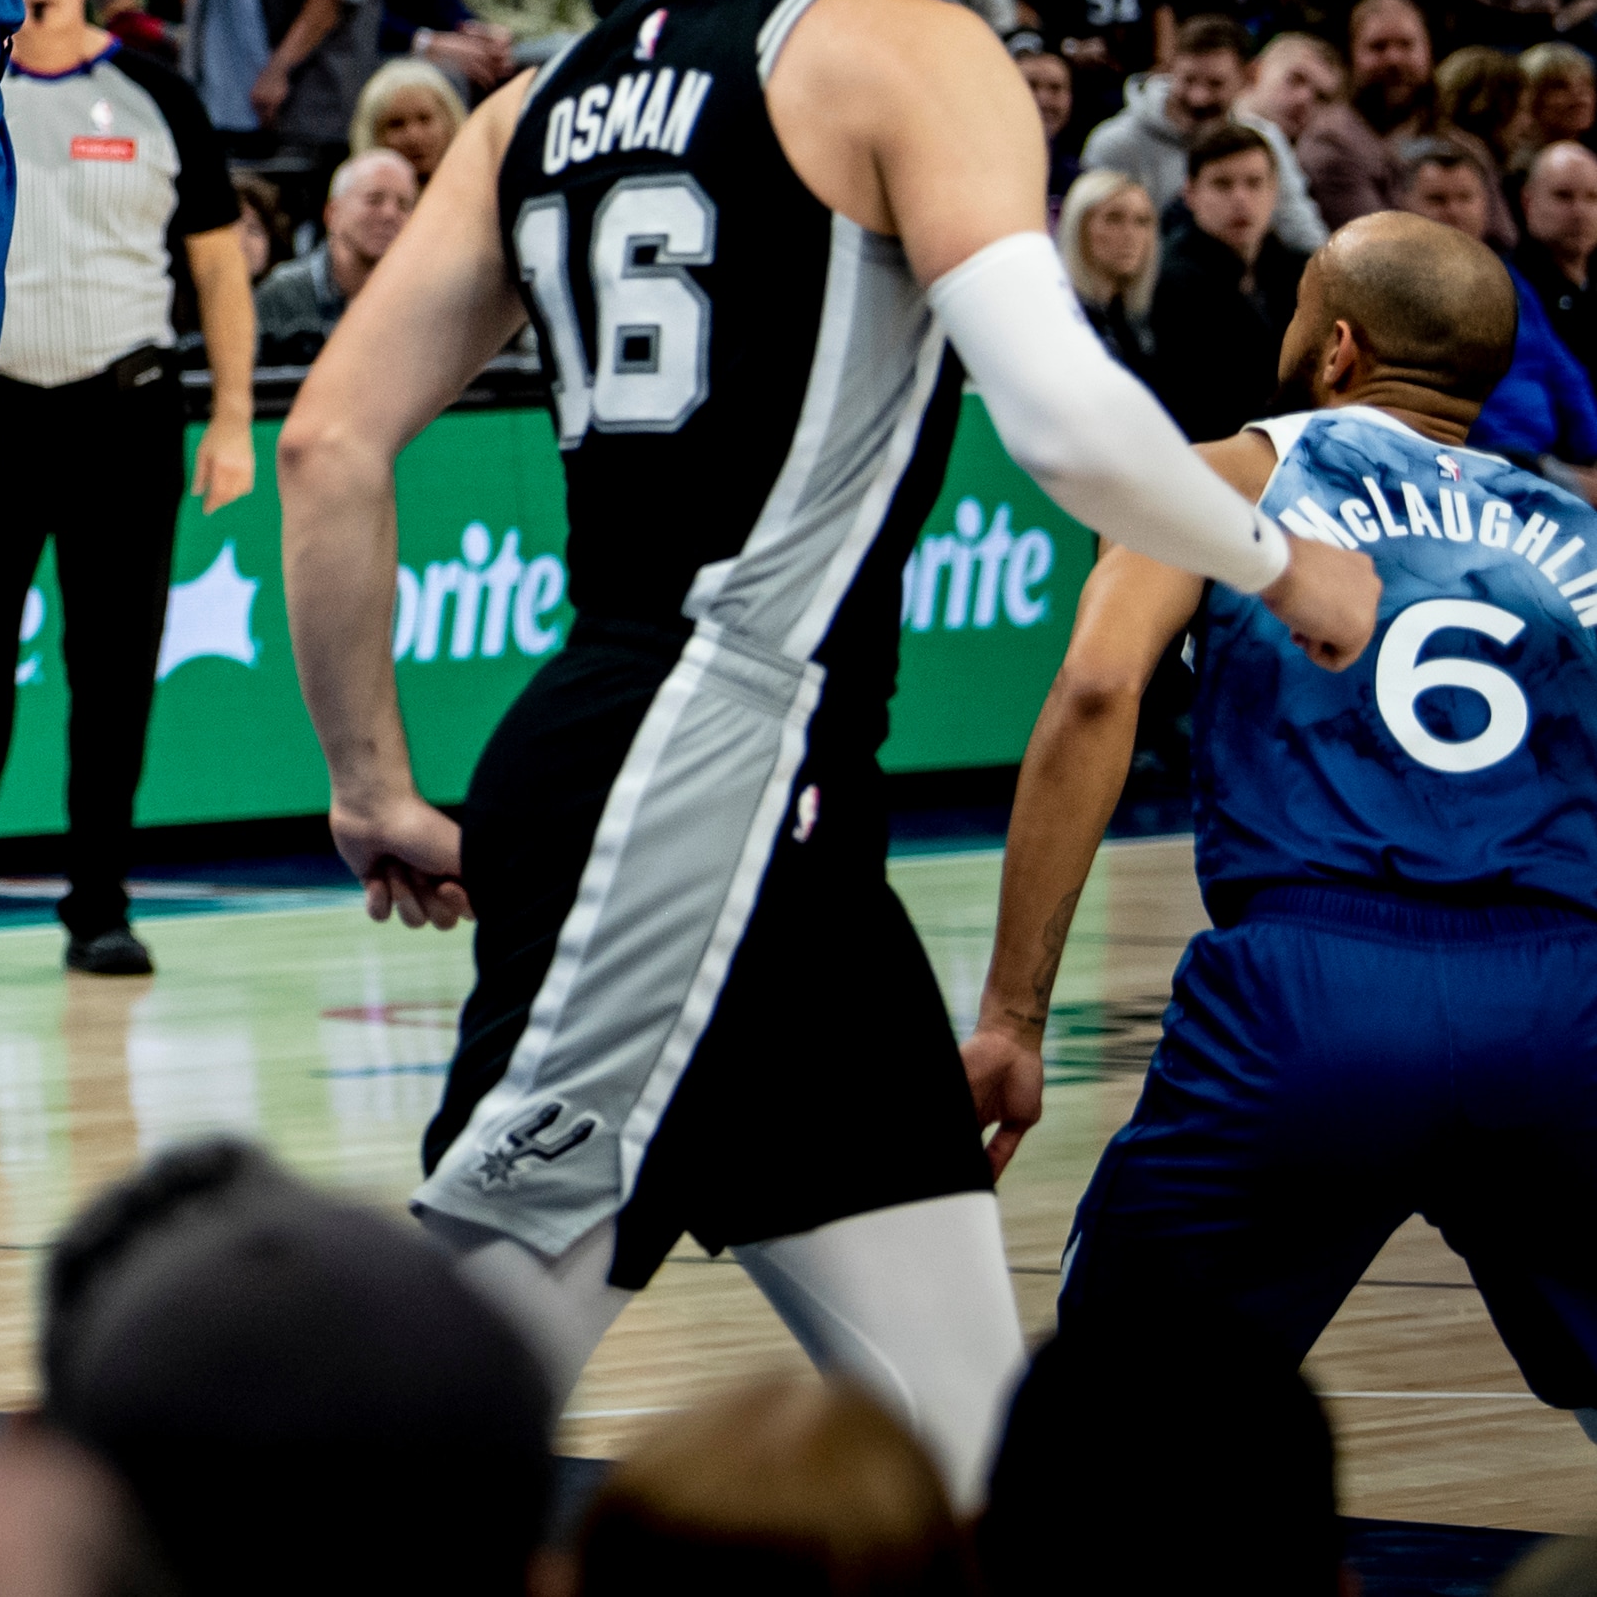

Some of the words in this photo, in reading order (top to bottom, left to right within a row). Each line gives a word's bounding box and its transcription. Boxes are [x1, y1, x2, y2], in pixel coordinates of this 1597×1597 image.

[541, 67, 713, 177] OSMAN
[512, 172, 718, 451] 16
[1375, 597, 1529, 775] 6
